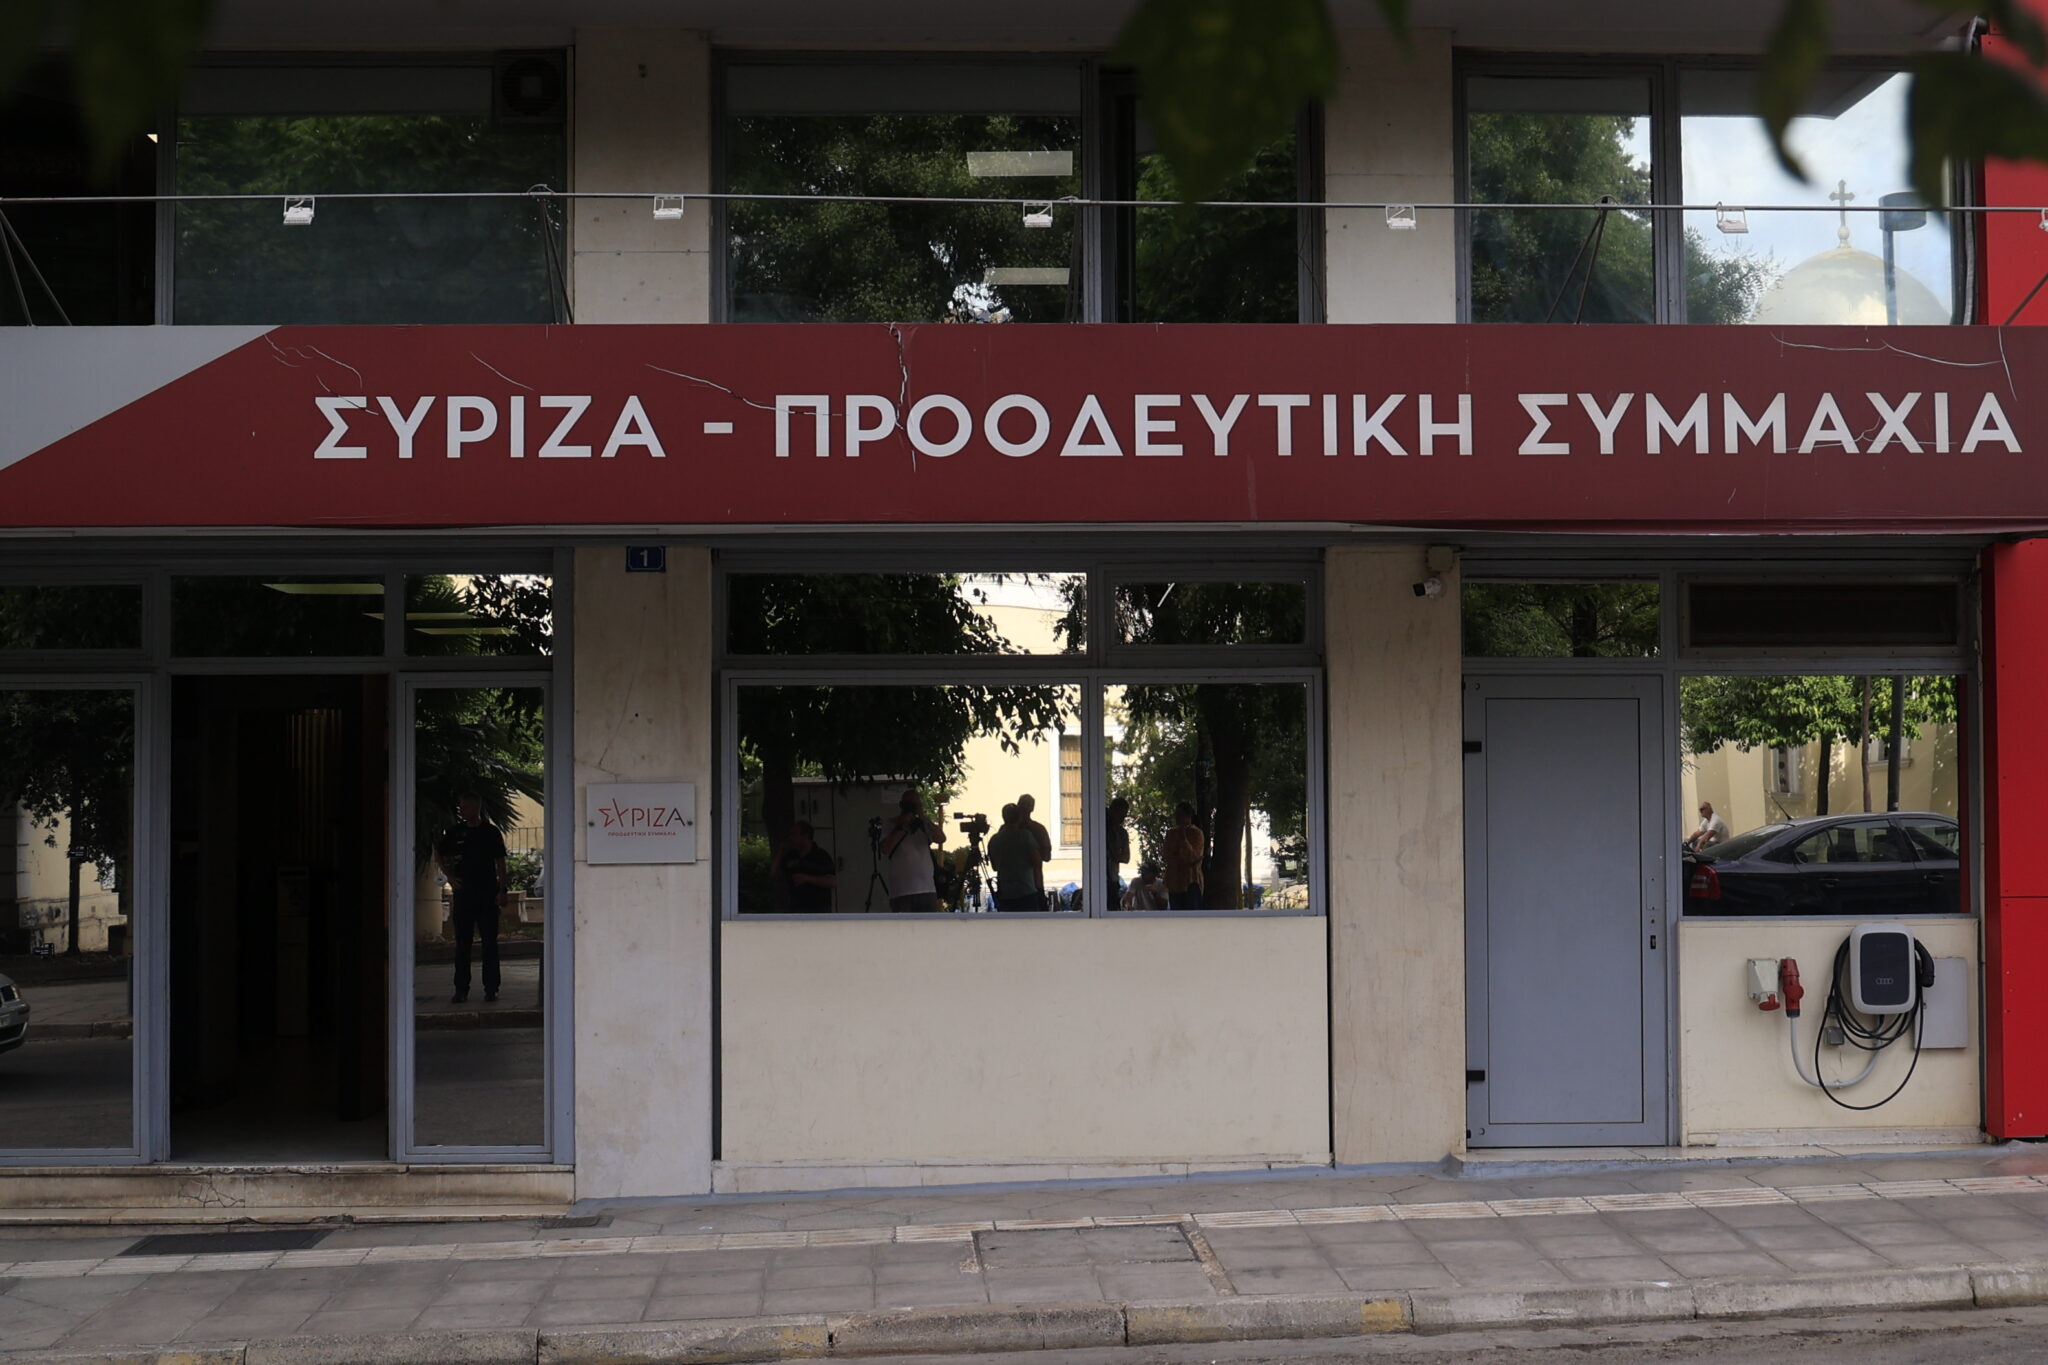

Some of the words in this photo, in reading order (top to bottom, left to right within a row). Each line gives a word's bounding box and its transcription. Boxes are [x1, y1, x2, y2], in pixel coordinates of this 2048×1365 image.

[314, 395, 666, 459] ΣΥΡΙΖΑ
[703, 422, 733, 434] -
[775, 394, 1474, 458] ΠΡΟΟΔΕΥΤΙΚΗ
[1518, 392, 2022, 456] ΣΥΜΜΑΧΙΑ
[639, 549, 648, 567] 1
[598, 798, 686, 828] ΣΥΡΙΖΑ
